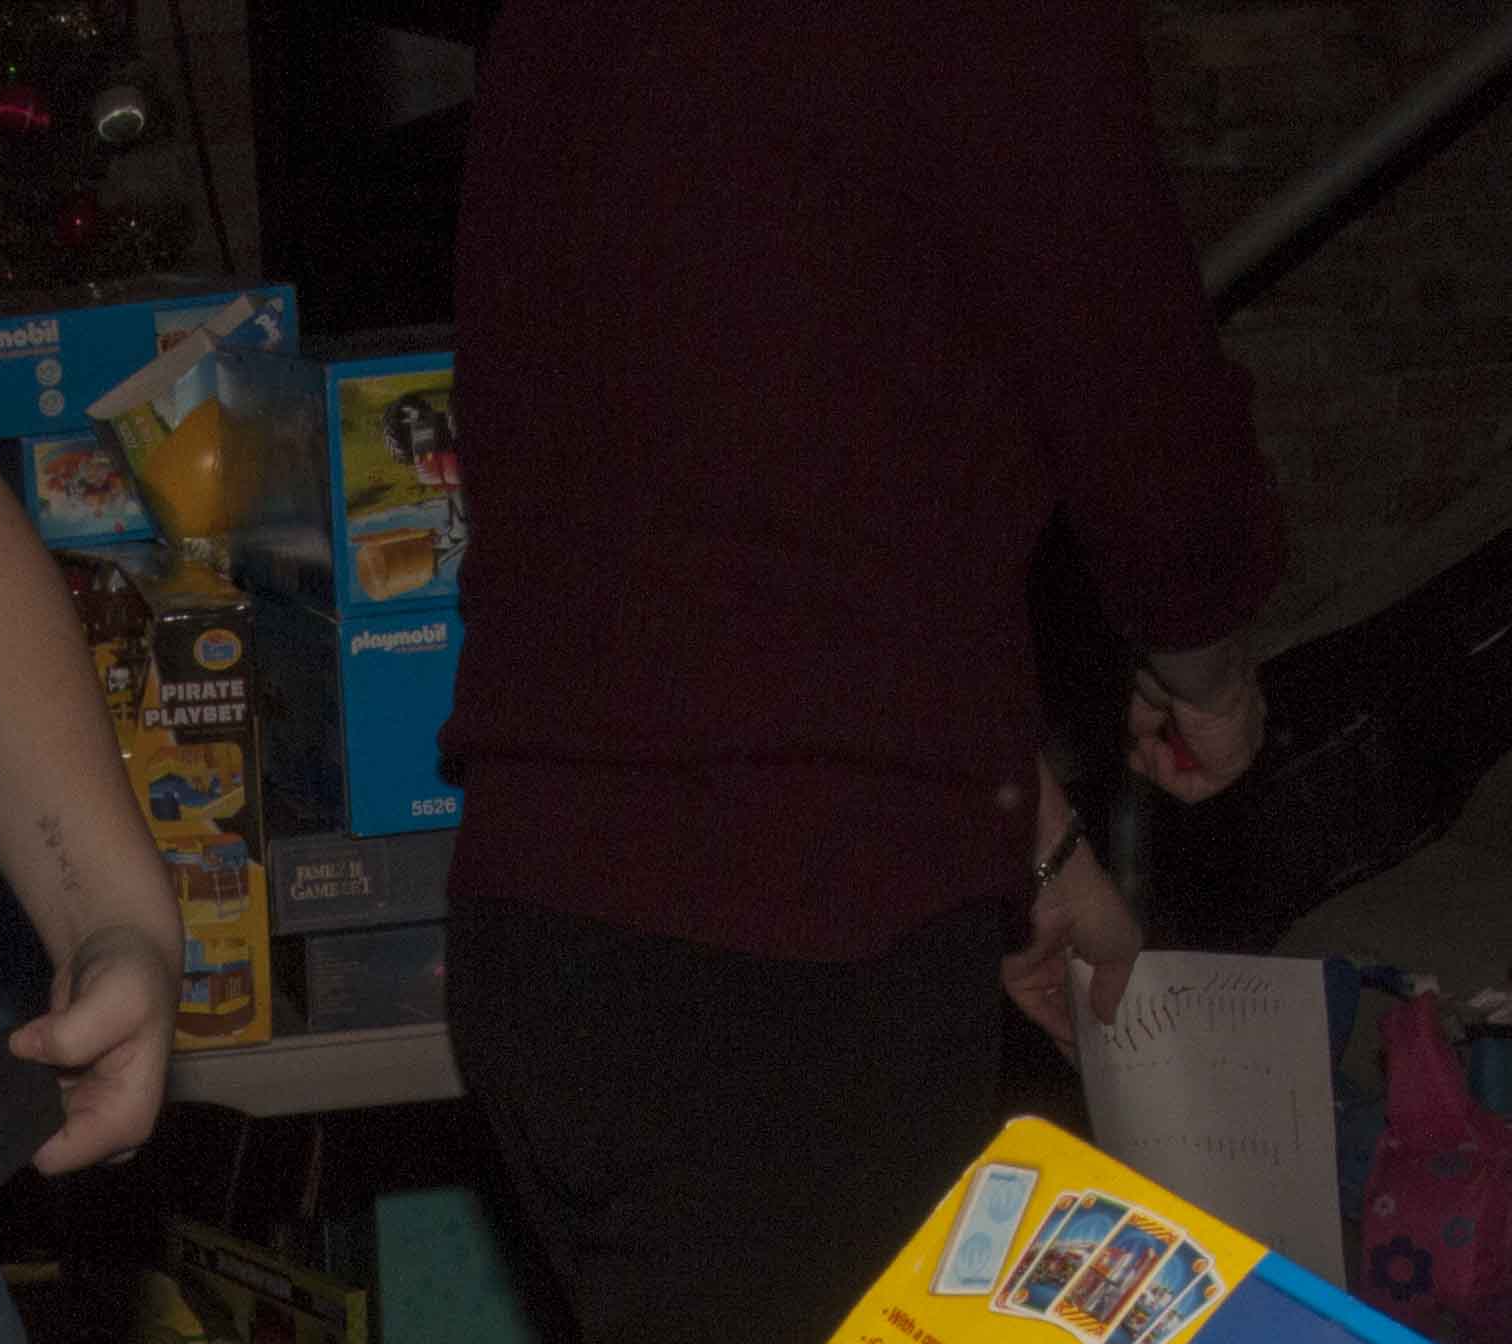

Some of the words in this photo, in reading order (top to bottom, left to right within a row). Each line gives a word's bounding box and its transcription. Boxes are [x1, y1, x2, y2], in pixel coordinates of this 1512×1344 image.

[161, 679, 245, 701] PIRATE
[144, 703, 246, 727] PLAYSET
[887, 1307, 915, 1334] With
